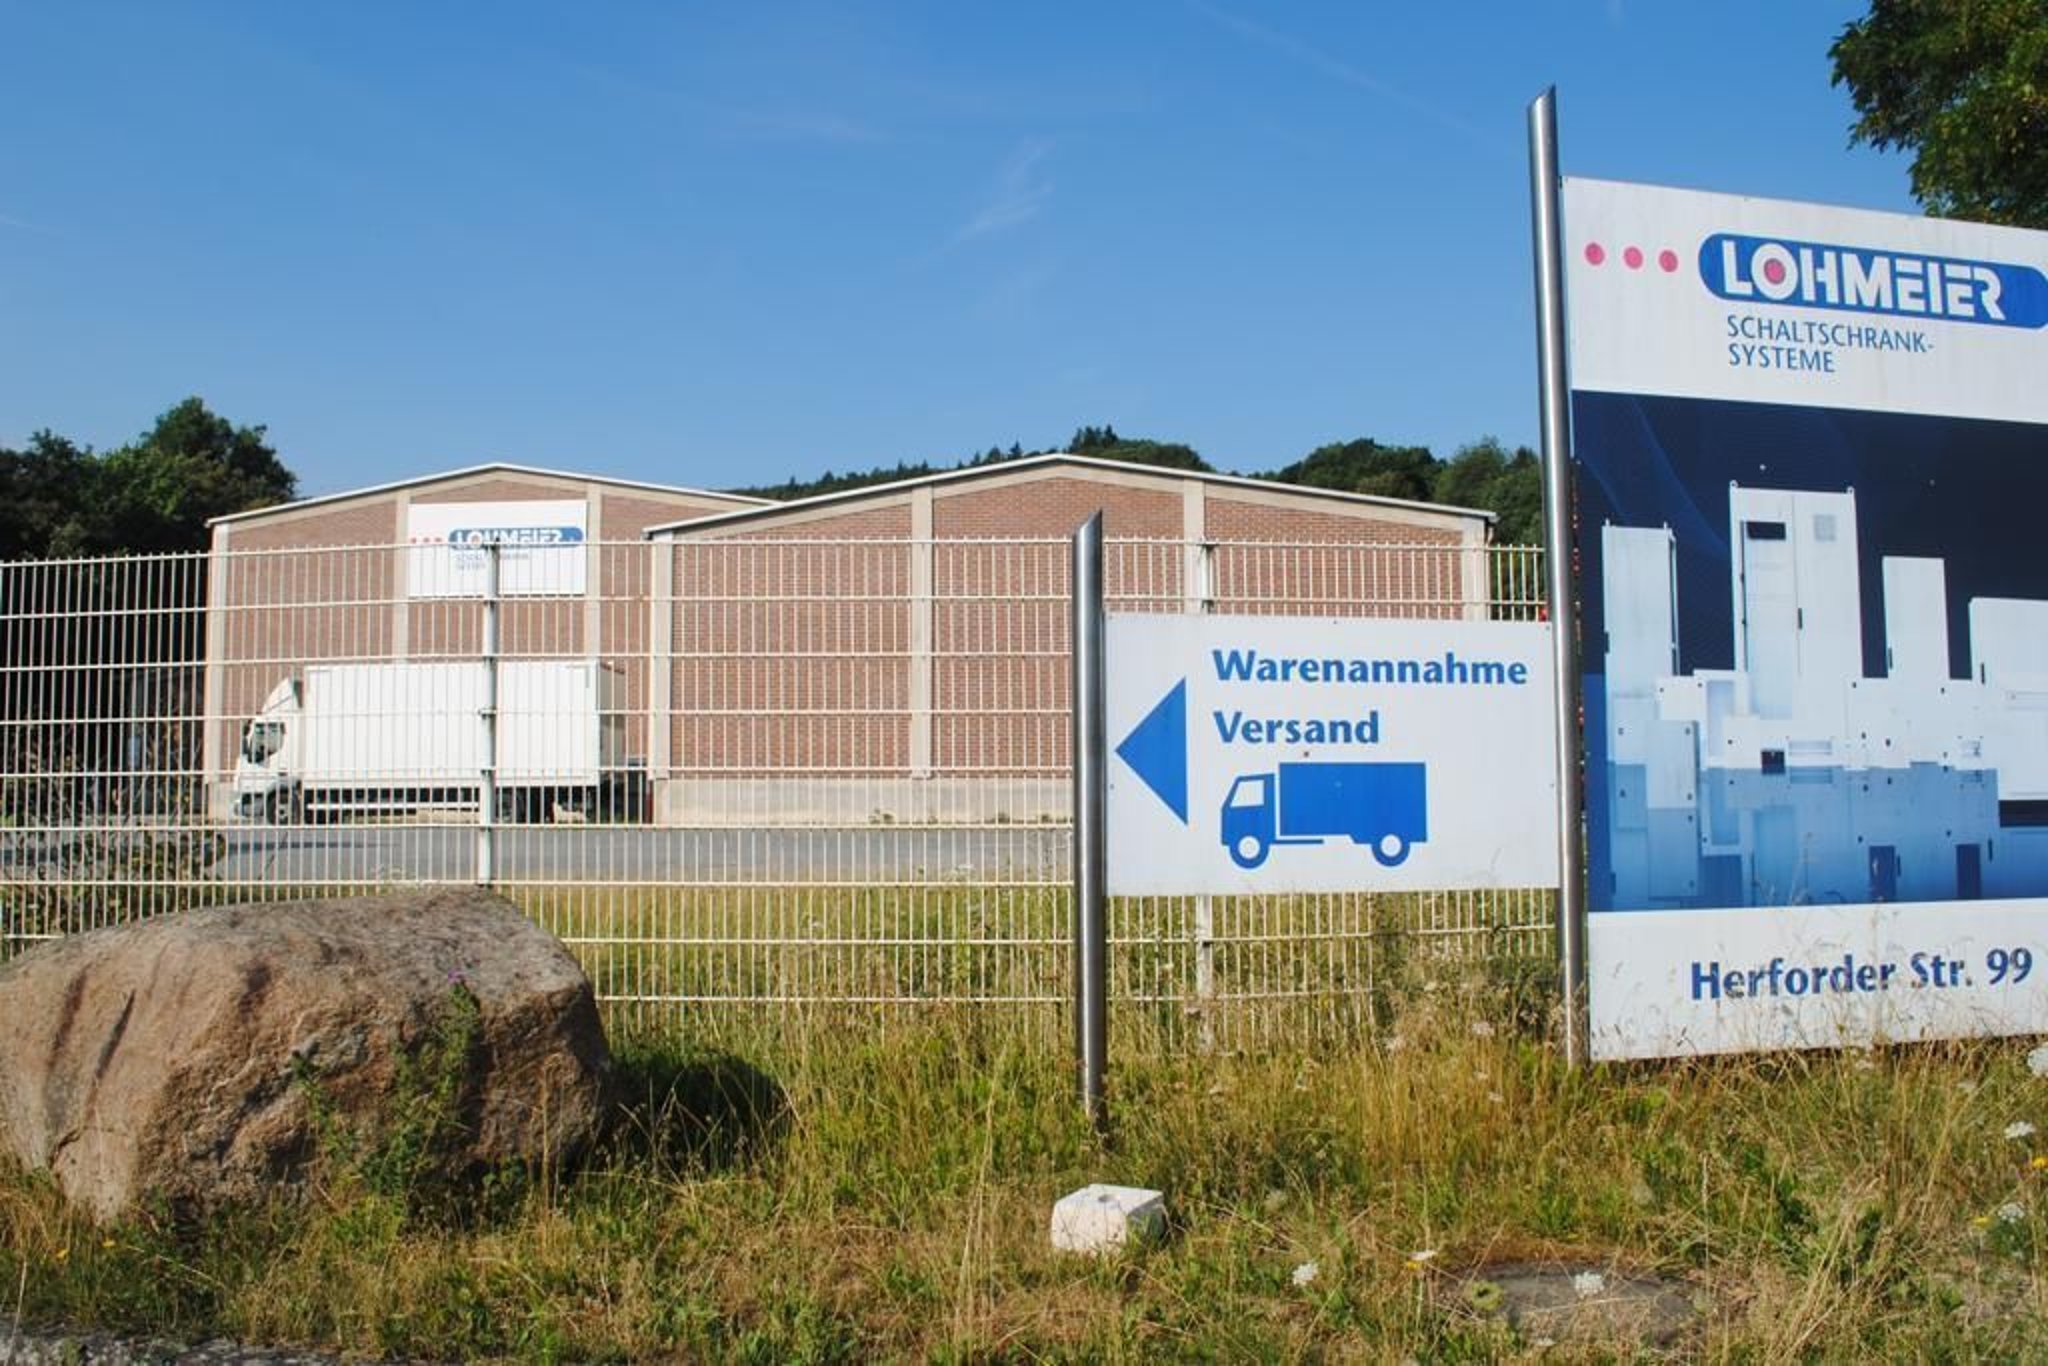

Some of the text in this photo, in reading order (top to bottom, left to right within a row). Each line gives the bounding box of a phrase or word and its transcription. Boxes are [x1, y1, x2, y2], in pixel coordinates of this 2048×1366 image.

[1721, 239, 2007, 321] LOHMEIER
[1727, 315, 1936, 354] SCHALTSCHRANK-
[1727, 343, 1836, 374] SYSTEME
[1213, 649, 1528, 685] Warenannahme
[1213, 710, 1380, 745] Versand
[1691, 947, 2033, 1000] Herforder Str. 99
